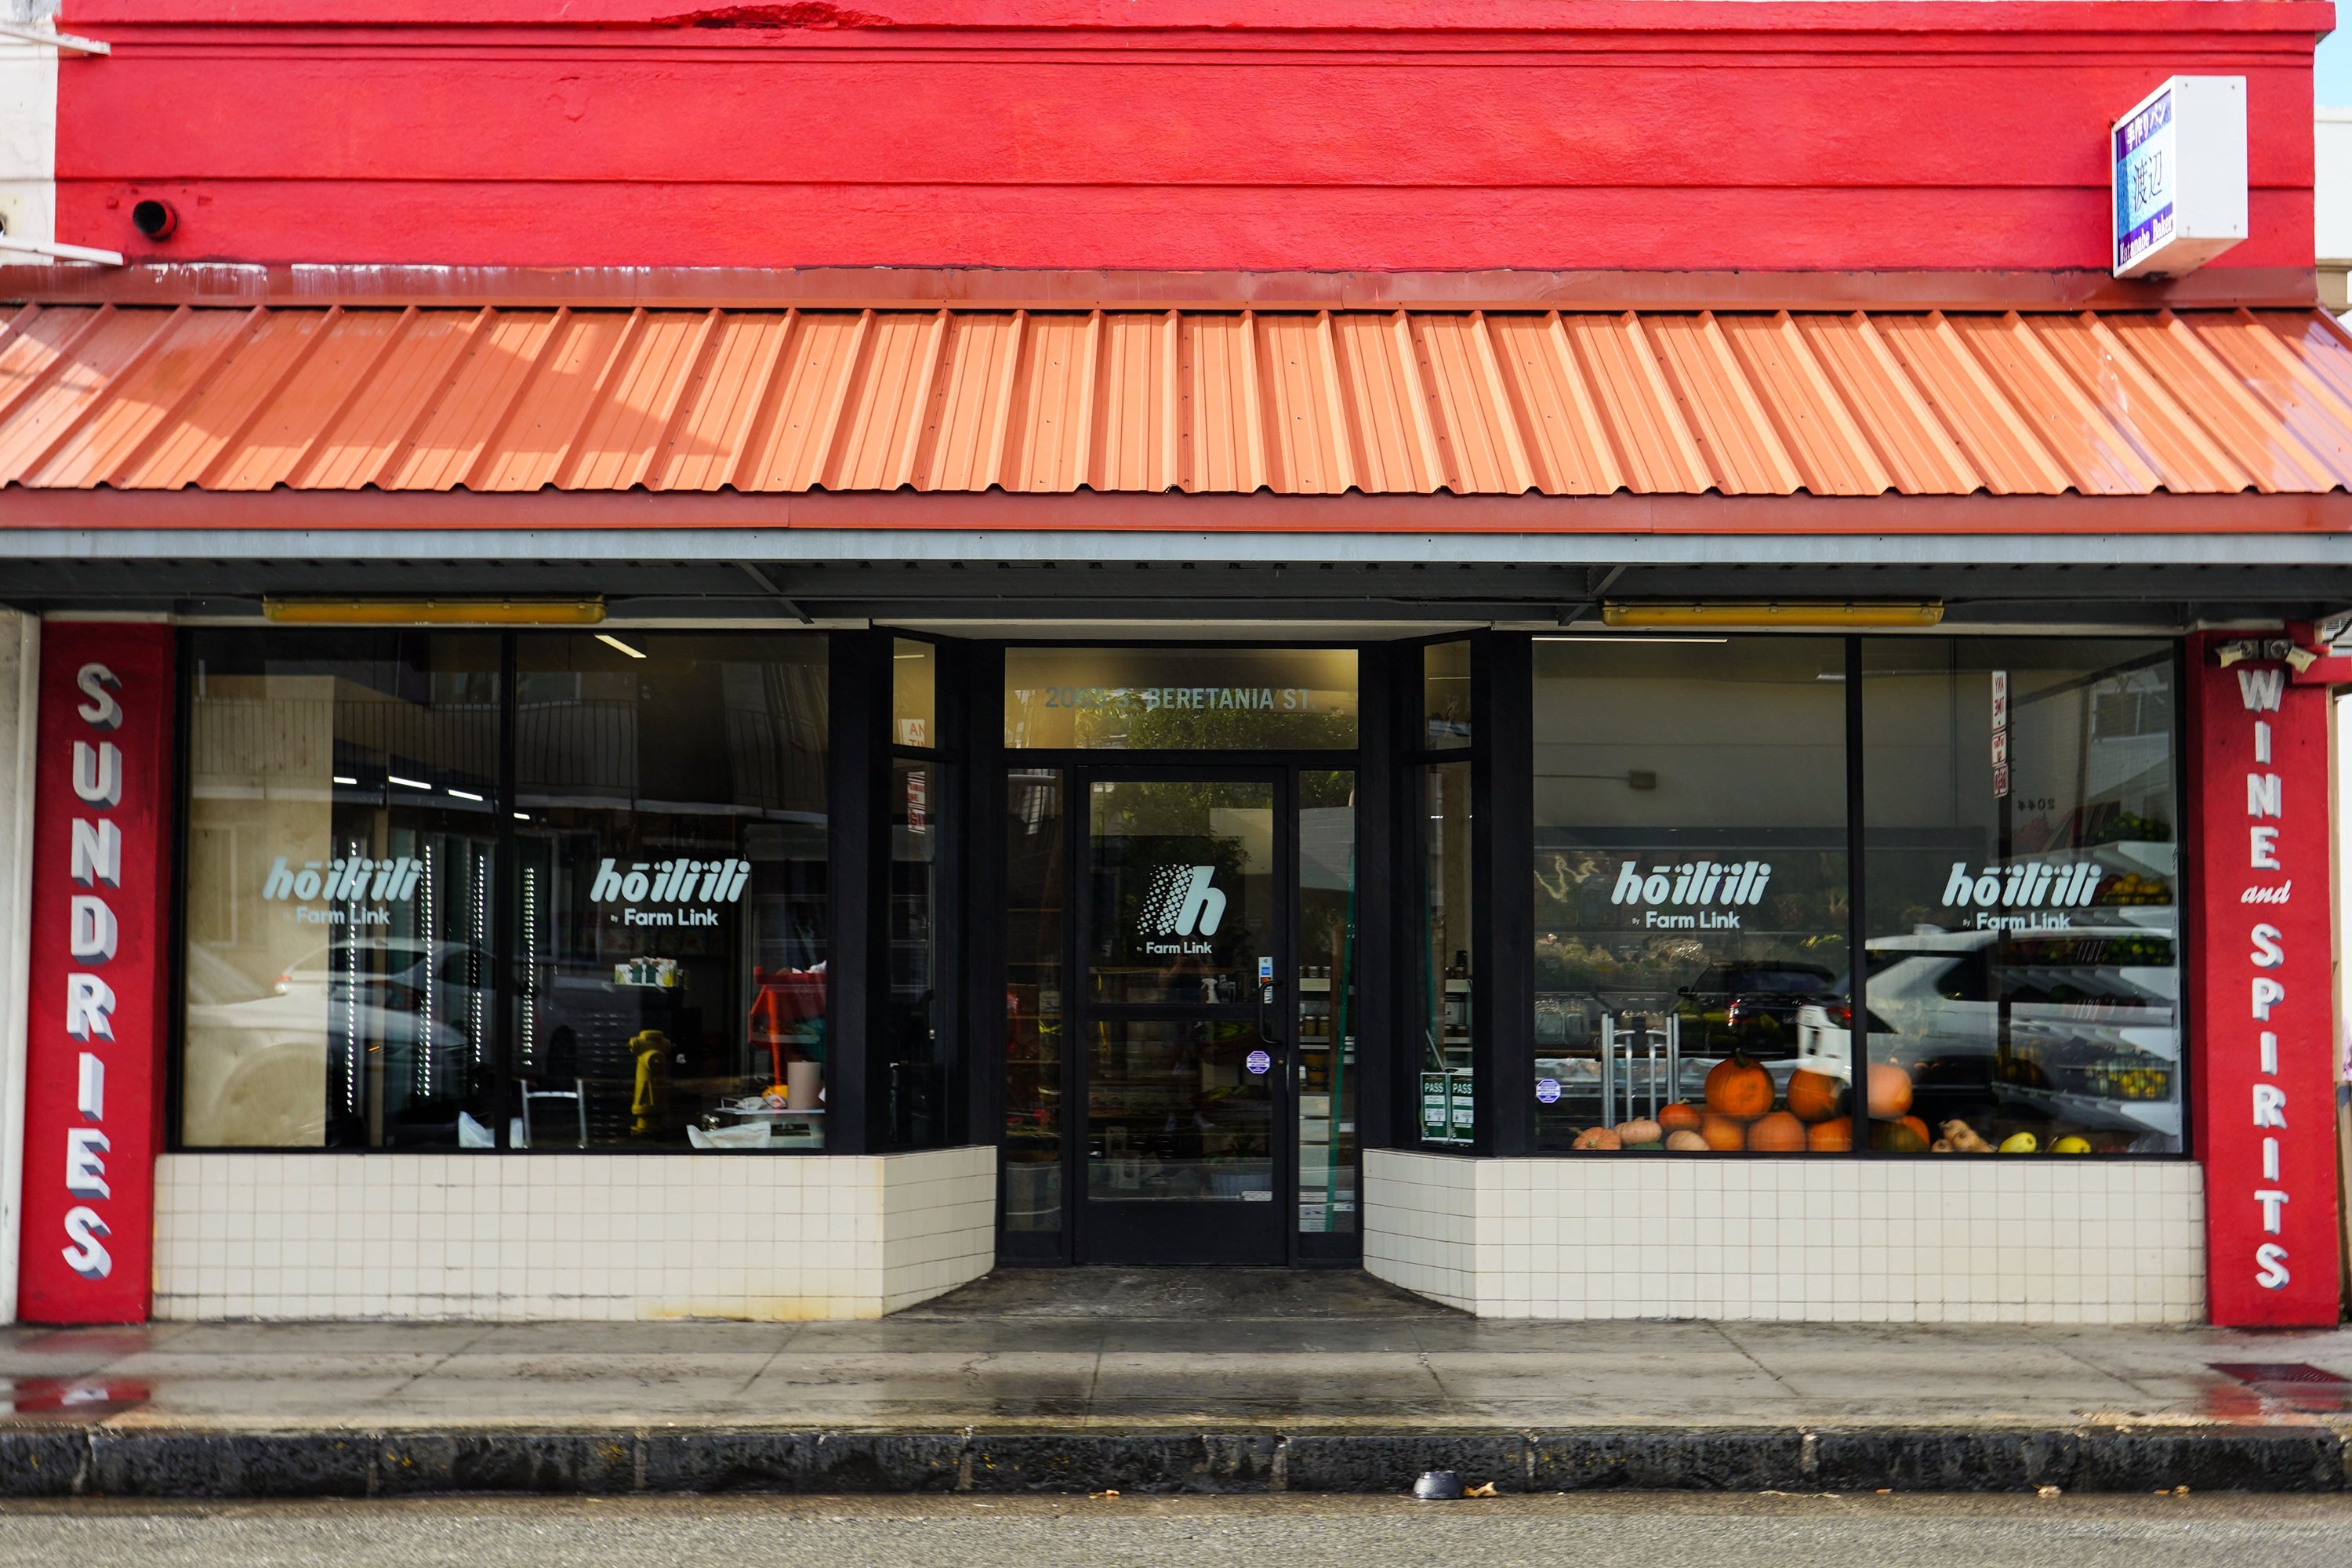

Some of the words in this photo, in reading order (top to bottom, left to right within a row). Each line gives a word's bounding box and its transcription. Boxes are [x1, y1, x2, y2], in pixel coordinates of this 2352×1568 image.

[2125, 102, 2166, 150] 手作りパン
[2119, 227, 2151, 265] Watanabe
[1148, 688, 1275, 710] BERETANIA
[1283, 688, 1317, 710] ST.
[2237, 669, 2285, 873] WINE
[2241, 880, 2292, 905] and
[296, 906, 345, 924] Farm
[350, 906, 391, 925] Link
[624, 908, 673, 926] Farm
[678, 908, 719, 926] Link
[1646, 911, 1695, 929] Farm
[1700, 911, 1740, 929] Link
[1976, 912, 2026, 931] Farm
[2031, 912, 2072, 930] Link
[1145, 942, 1181, 954] Farm
[1183, 942, 1212, 954] Link
[62, 662, 122, 1279] SUNDRIES
[1424, 1082, 1444, 1093] PASS
[1452, 1083, 1473, 1094] PASS
[2249, 923, 2292, 1290] SPIRITS
